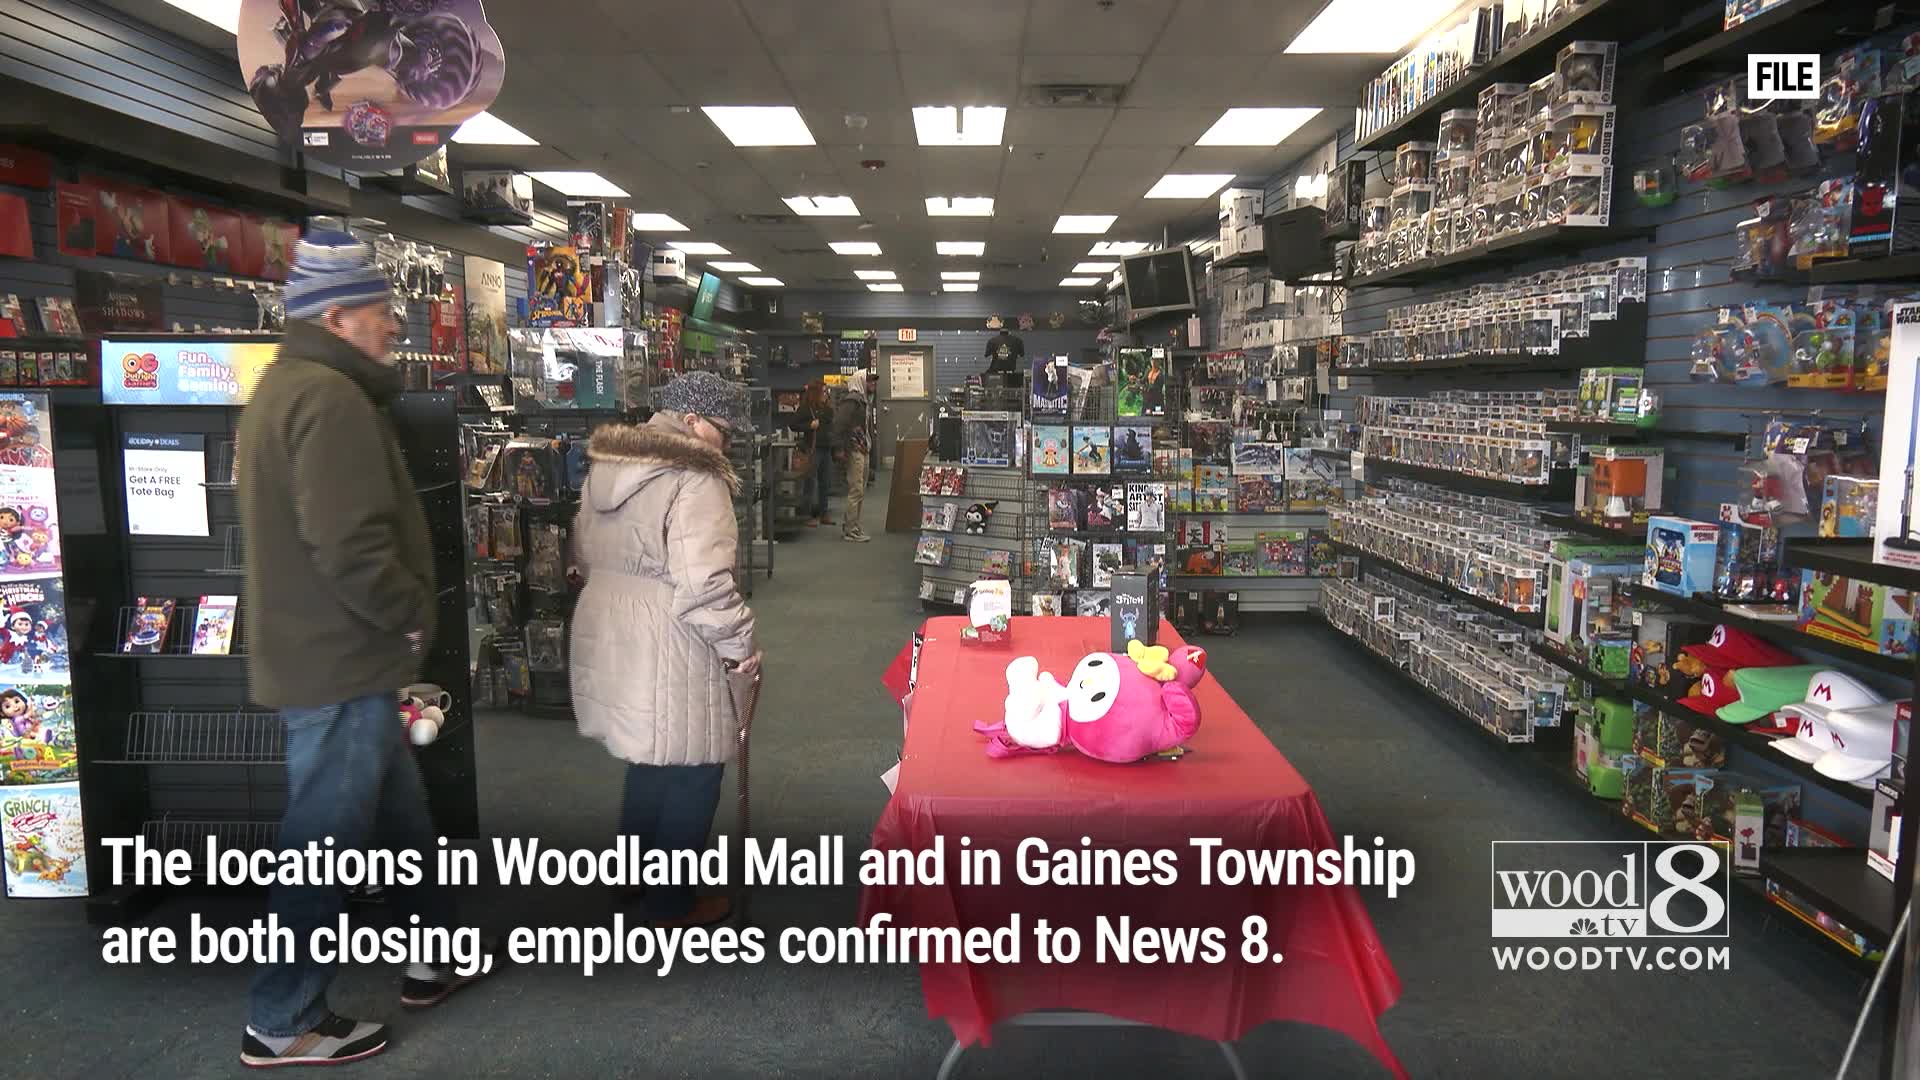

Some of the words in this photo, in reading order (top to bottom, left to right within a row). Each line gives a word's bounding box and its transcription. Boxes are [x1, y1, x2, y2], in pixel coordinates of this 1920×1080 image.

[1604, 112, 1614, 129] BIG
[1602, 132, 1613, 156] BIRD
[481, 271, 502, 289] ANNO
[178, 351, 212, 364] Fun.
[178, 365, 235, 381] Family.
[178, 379, 243, 395] Gaming.
[596, 373, 604, 395] FLASH
[129, 475, 147, 484] Get
[150, 475, 157, 484] A
[158, 476, 181, 485] FREE
[130, 487, 152, 496] Tote
[155, 487, 175, 499] Bag
[1129, 493, 1163, 501] ARTST
[8, 593, 45, 605] HEROES
[1712, 630, 1722, 643] M
[1702, 678, 1712, 693] M
[1813, 683, 1832, 701] M
[1800, 720, 1813, 737] M
[1831, 731, 1845, 748] M
[4, 799, 51, 817] GRINCH
